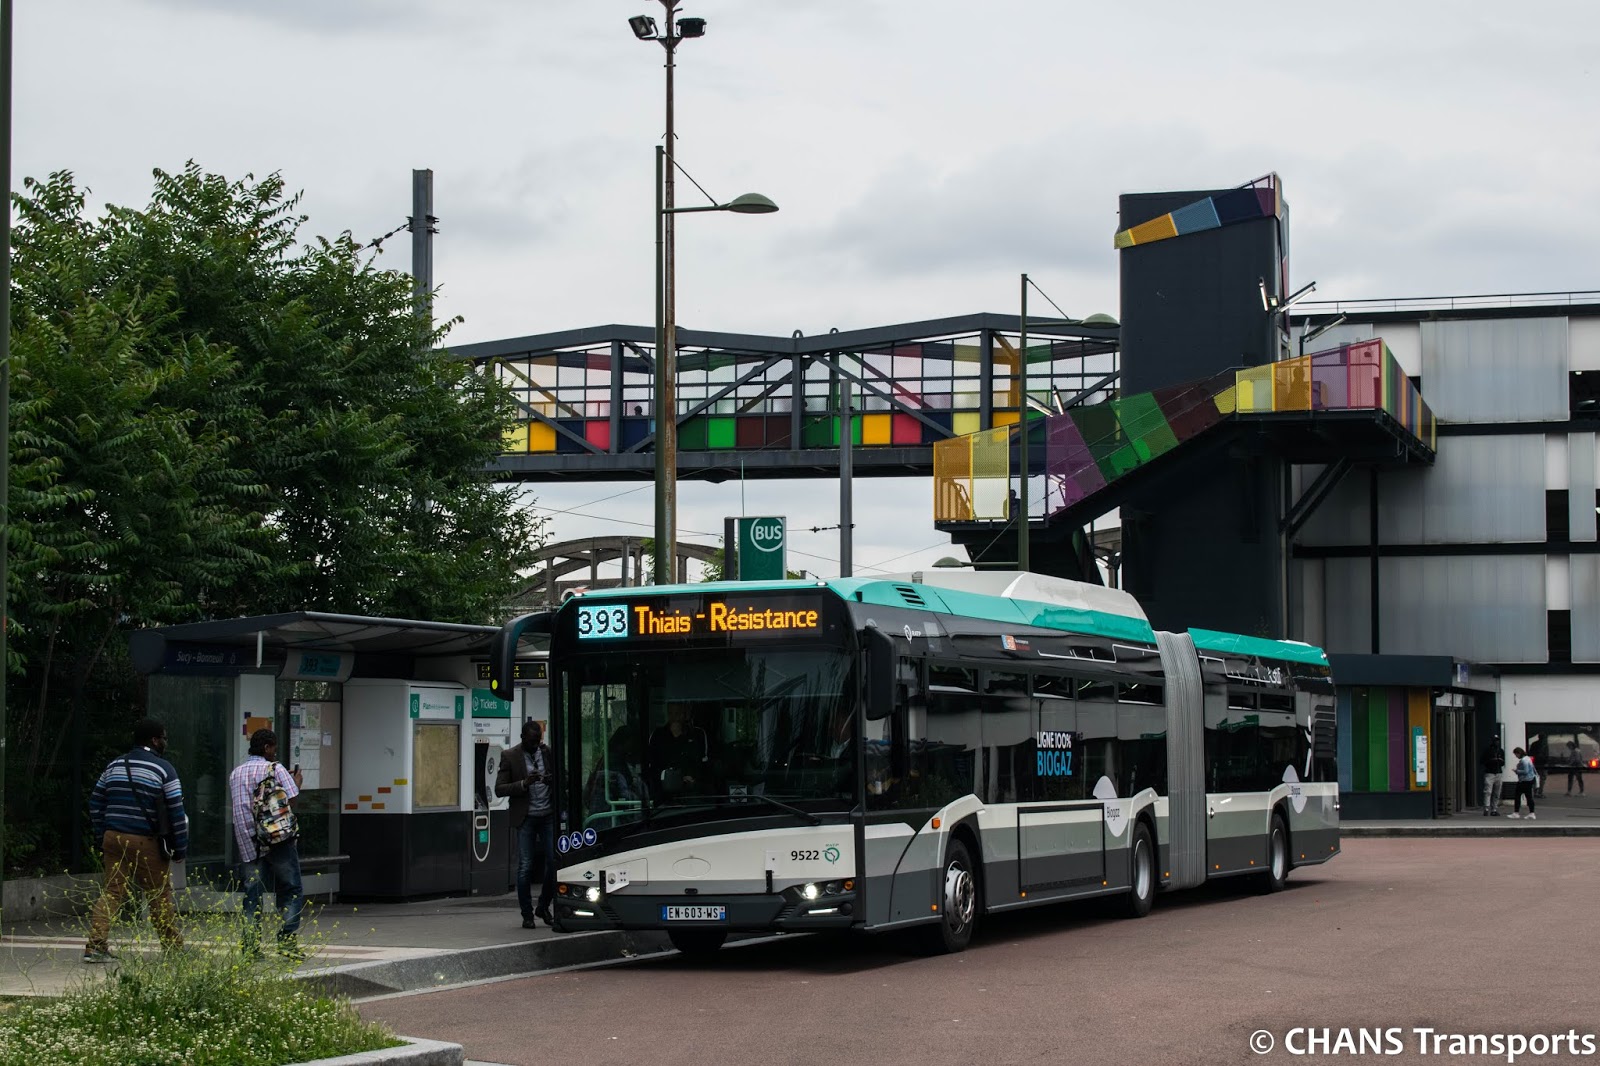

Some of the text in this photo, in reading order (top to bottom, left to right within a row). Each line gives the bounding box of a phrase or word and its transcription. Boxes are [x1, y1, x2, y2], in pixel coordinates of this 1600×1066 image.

[755, 525, 782, 540] BUS
[579, 609, 627, 635] 393
[634, 605, 691, 634] Thiais
[710, 602, 818, 631] Résistance
[480, 699, 497, 709] Tickets
[1037, 732, 1054, 748] LIGNE
[1055, 732, 1072, 749] 100%
[1037, 751, 1072, 776] BIOGAZ
[1107, 807, 1120, 821] Biogaz
[791, 850, 820, 861] 9522
